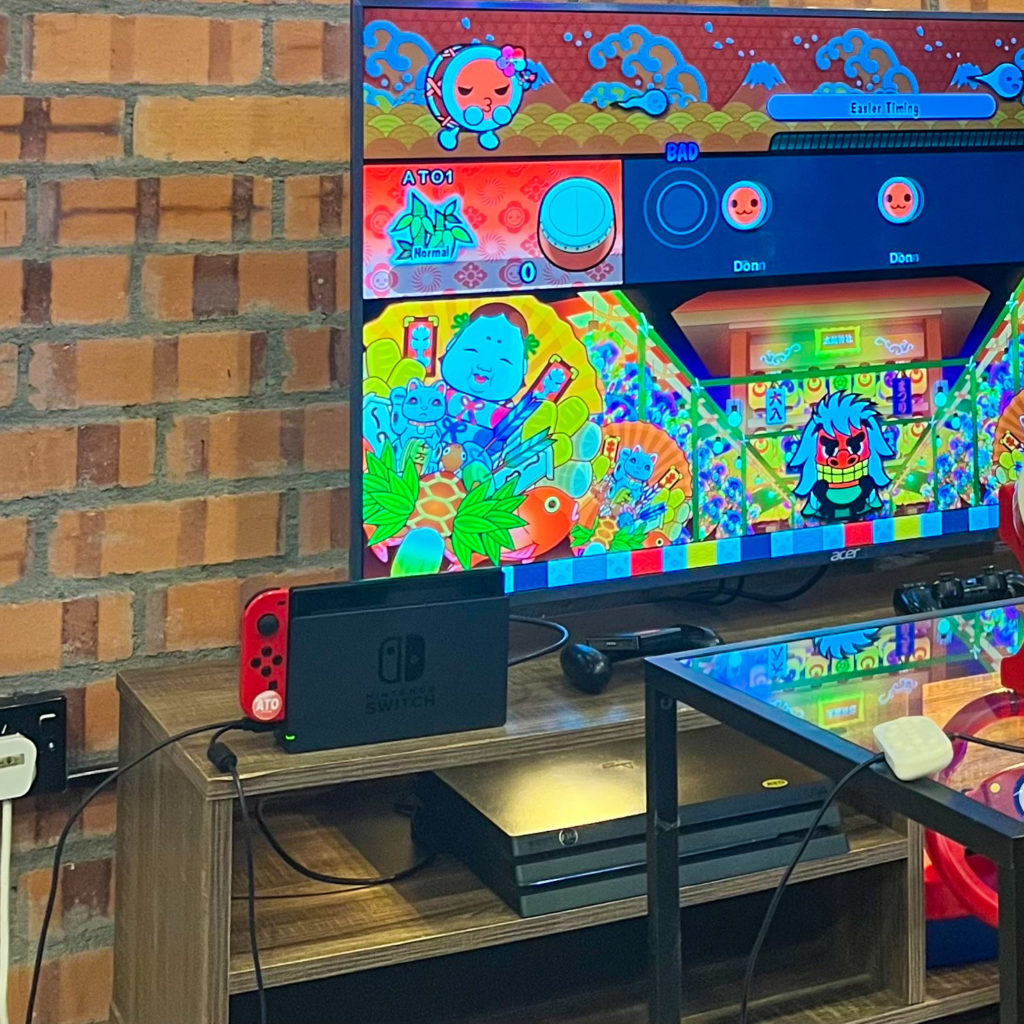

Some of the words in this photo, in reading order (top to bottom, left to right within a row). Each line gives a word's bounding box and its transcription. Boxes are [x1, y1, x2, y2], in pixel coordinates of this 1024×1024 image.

[851, 102, 882, 114] Easier
[886, 102, 919, 118] Timing
[665, 141, 699, 163] BAD
[402, 168, 454, 185] ATO1
[413, 245, 450, 259] Normal
[519, 260, 537, 284] 0
[830, 548, 861, 562] acer
[255, 698, 280, 712] ATO
[366, 693, 436, 714] SWITCH
